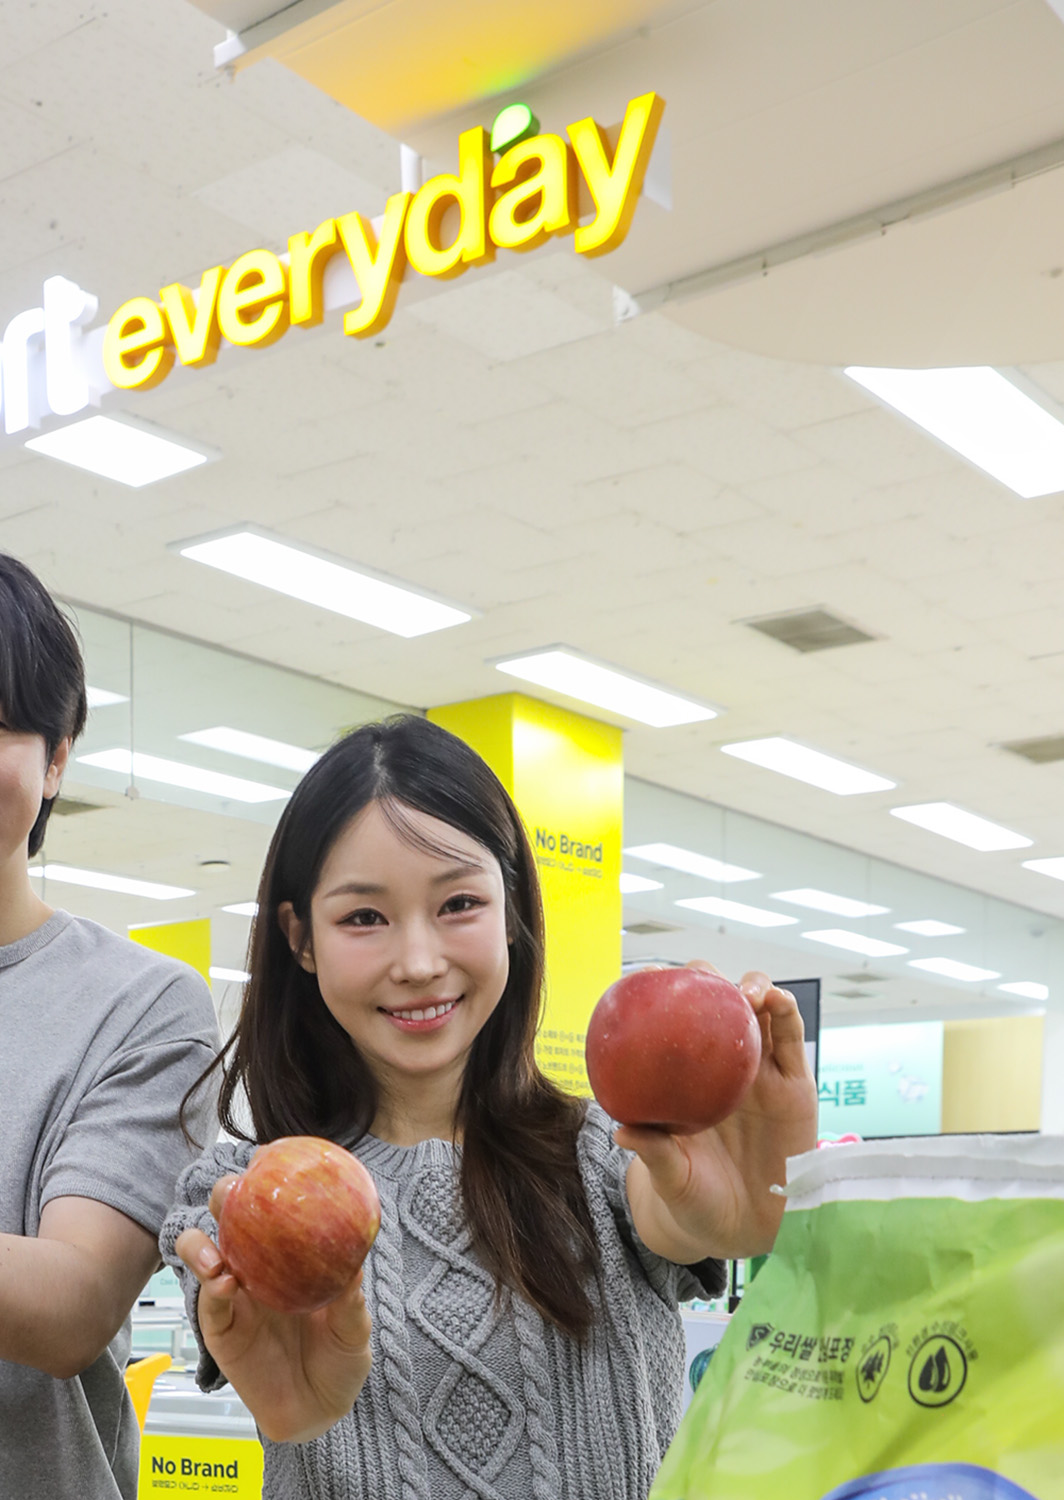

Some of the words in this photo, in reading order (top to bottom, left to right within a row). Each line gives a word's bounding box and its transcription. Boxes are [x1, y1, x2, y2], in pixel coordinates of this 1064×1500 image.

[103, 91, 665, 390] everyday
[536, 828, 556, 851] No
[560, 835, 603, 862] Brand
[819, 1080, 866, 1107] 식품
[152, 1456, 176, 1475] No
[180, 1458, 239, 1479] Brand
